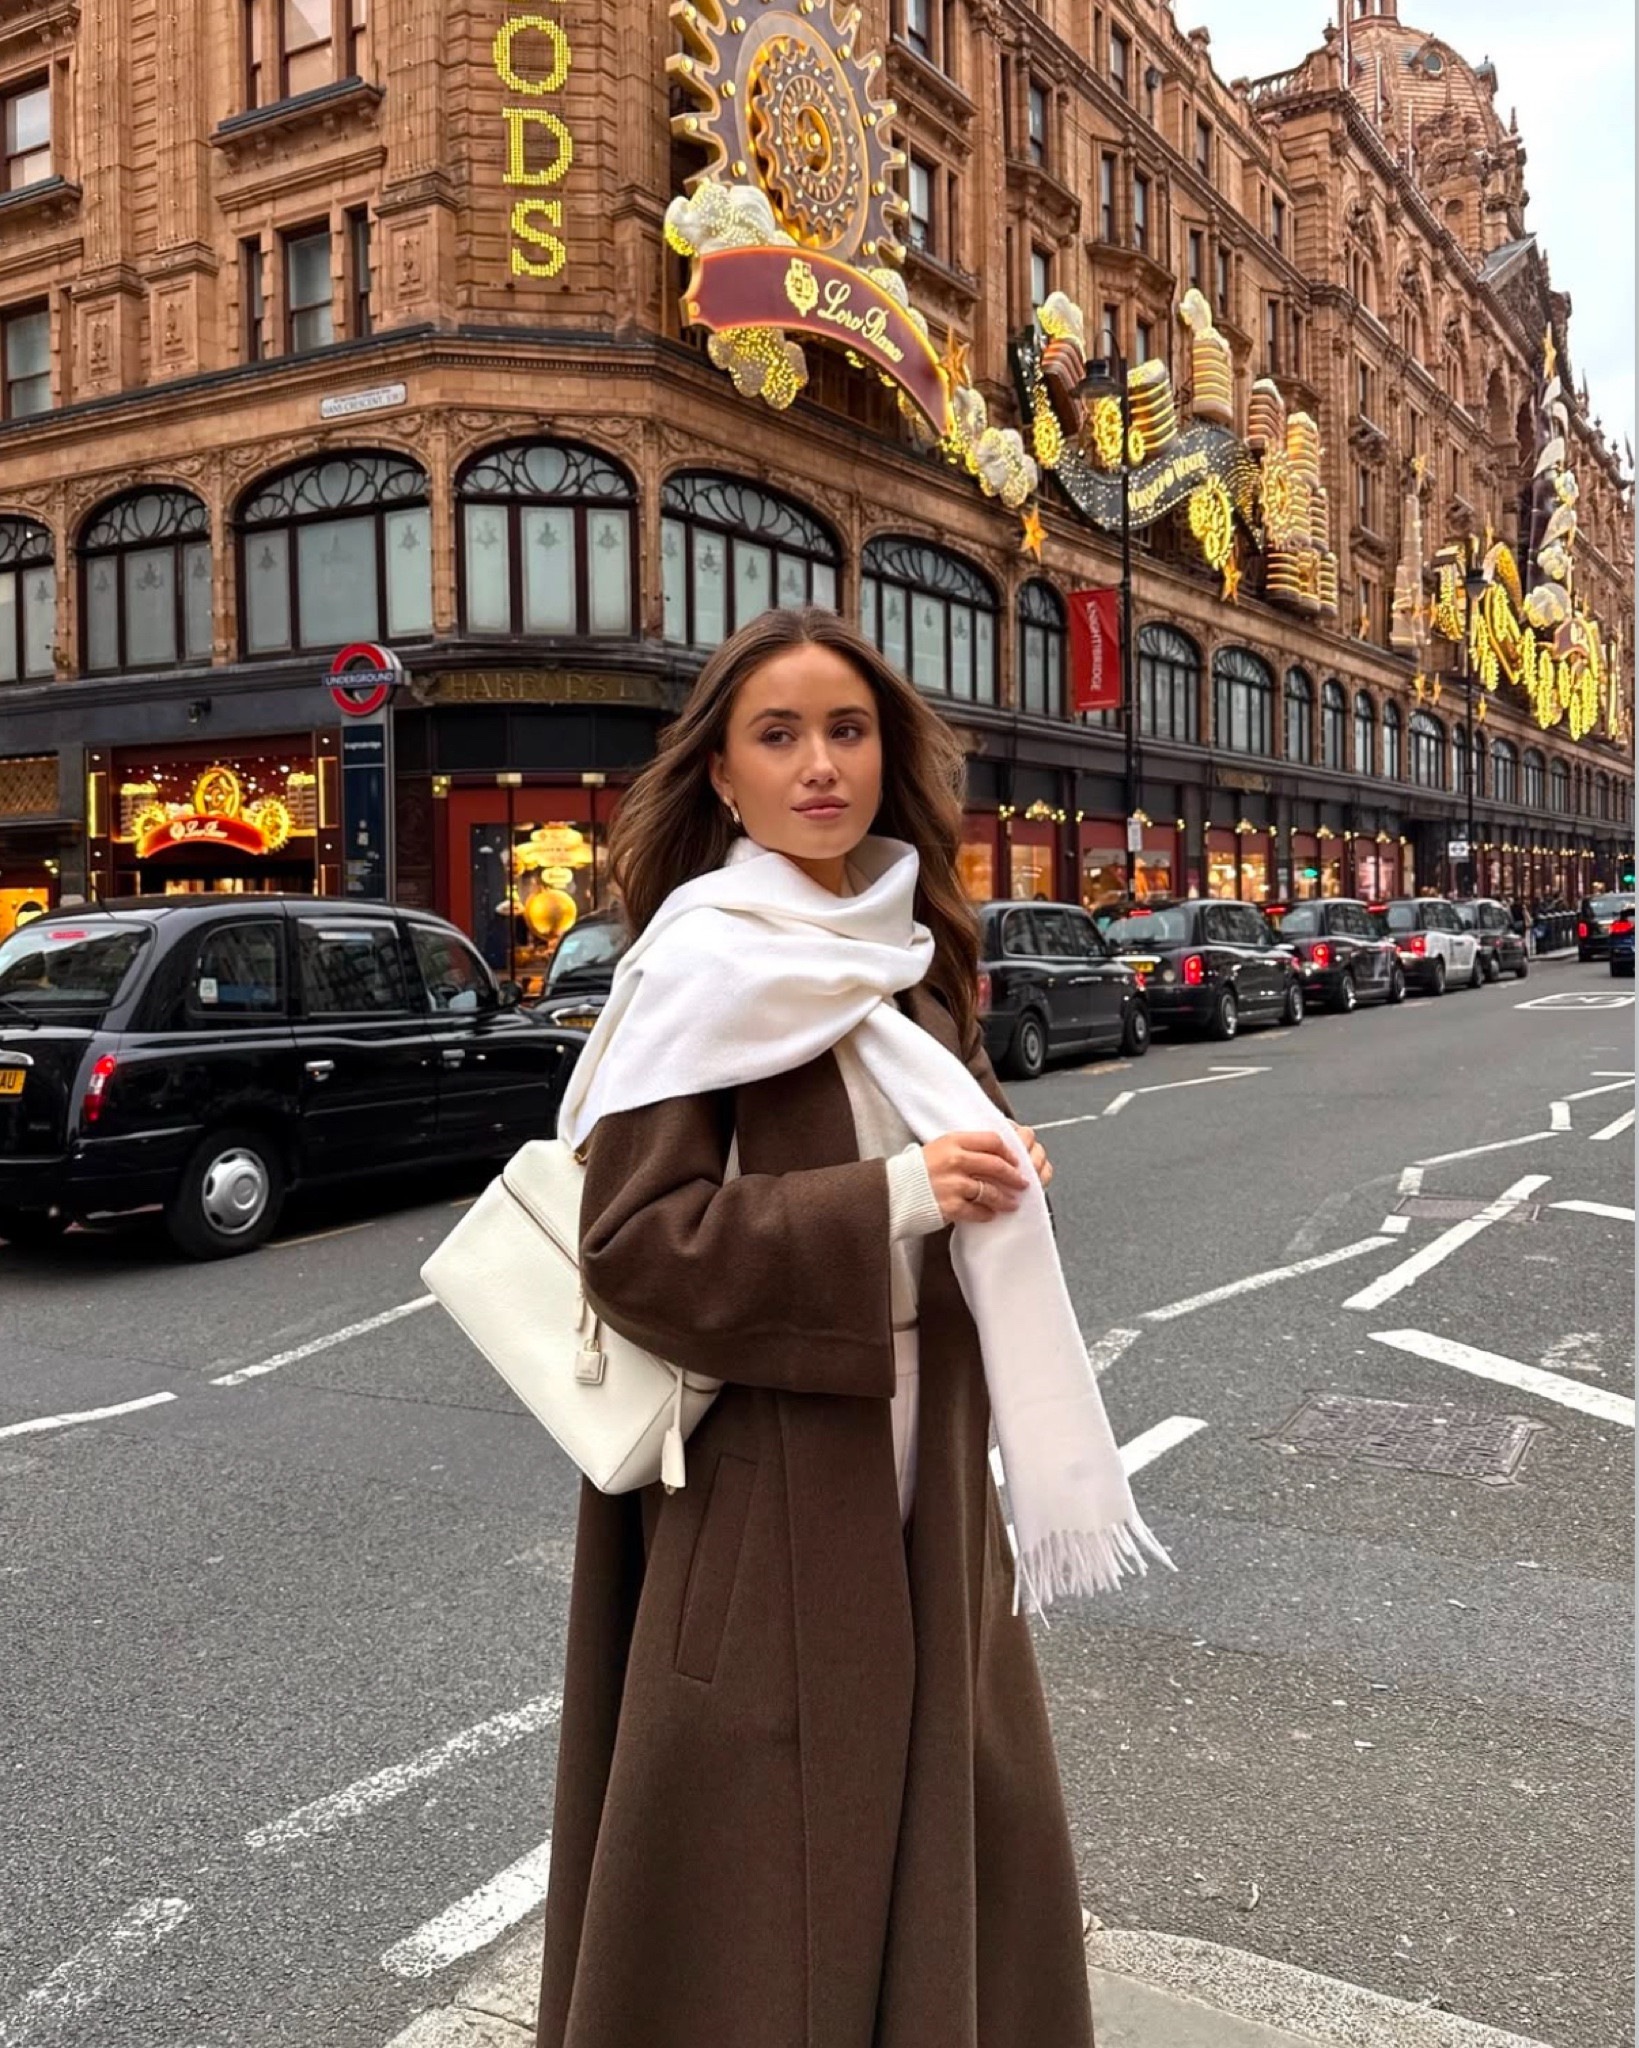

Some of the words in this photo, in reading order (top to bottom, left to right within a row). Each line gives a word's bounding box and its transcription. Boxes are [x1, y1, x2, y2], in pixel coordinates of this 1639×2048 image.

[493, 0, 573, 277] ODS
[817, 280, 864, 330] Loro
[862, 306, 904, 363] Piana
[325, 672, 393, 685] UNDERGROUND
